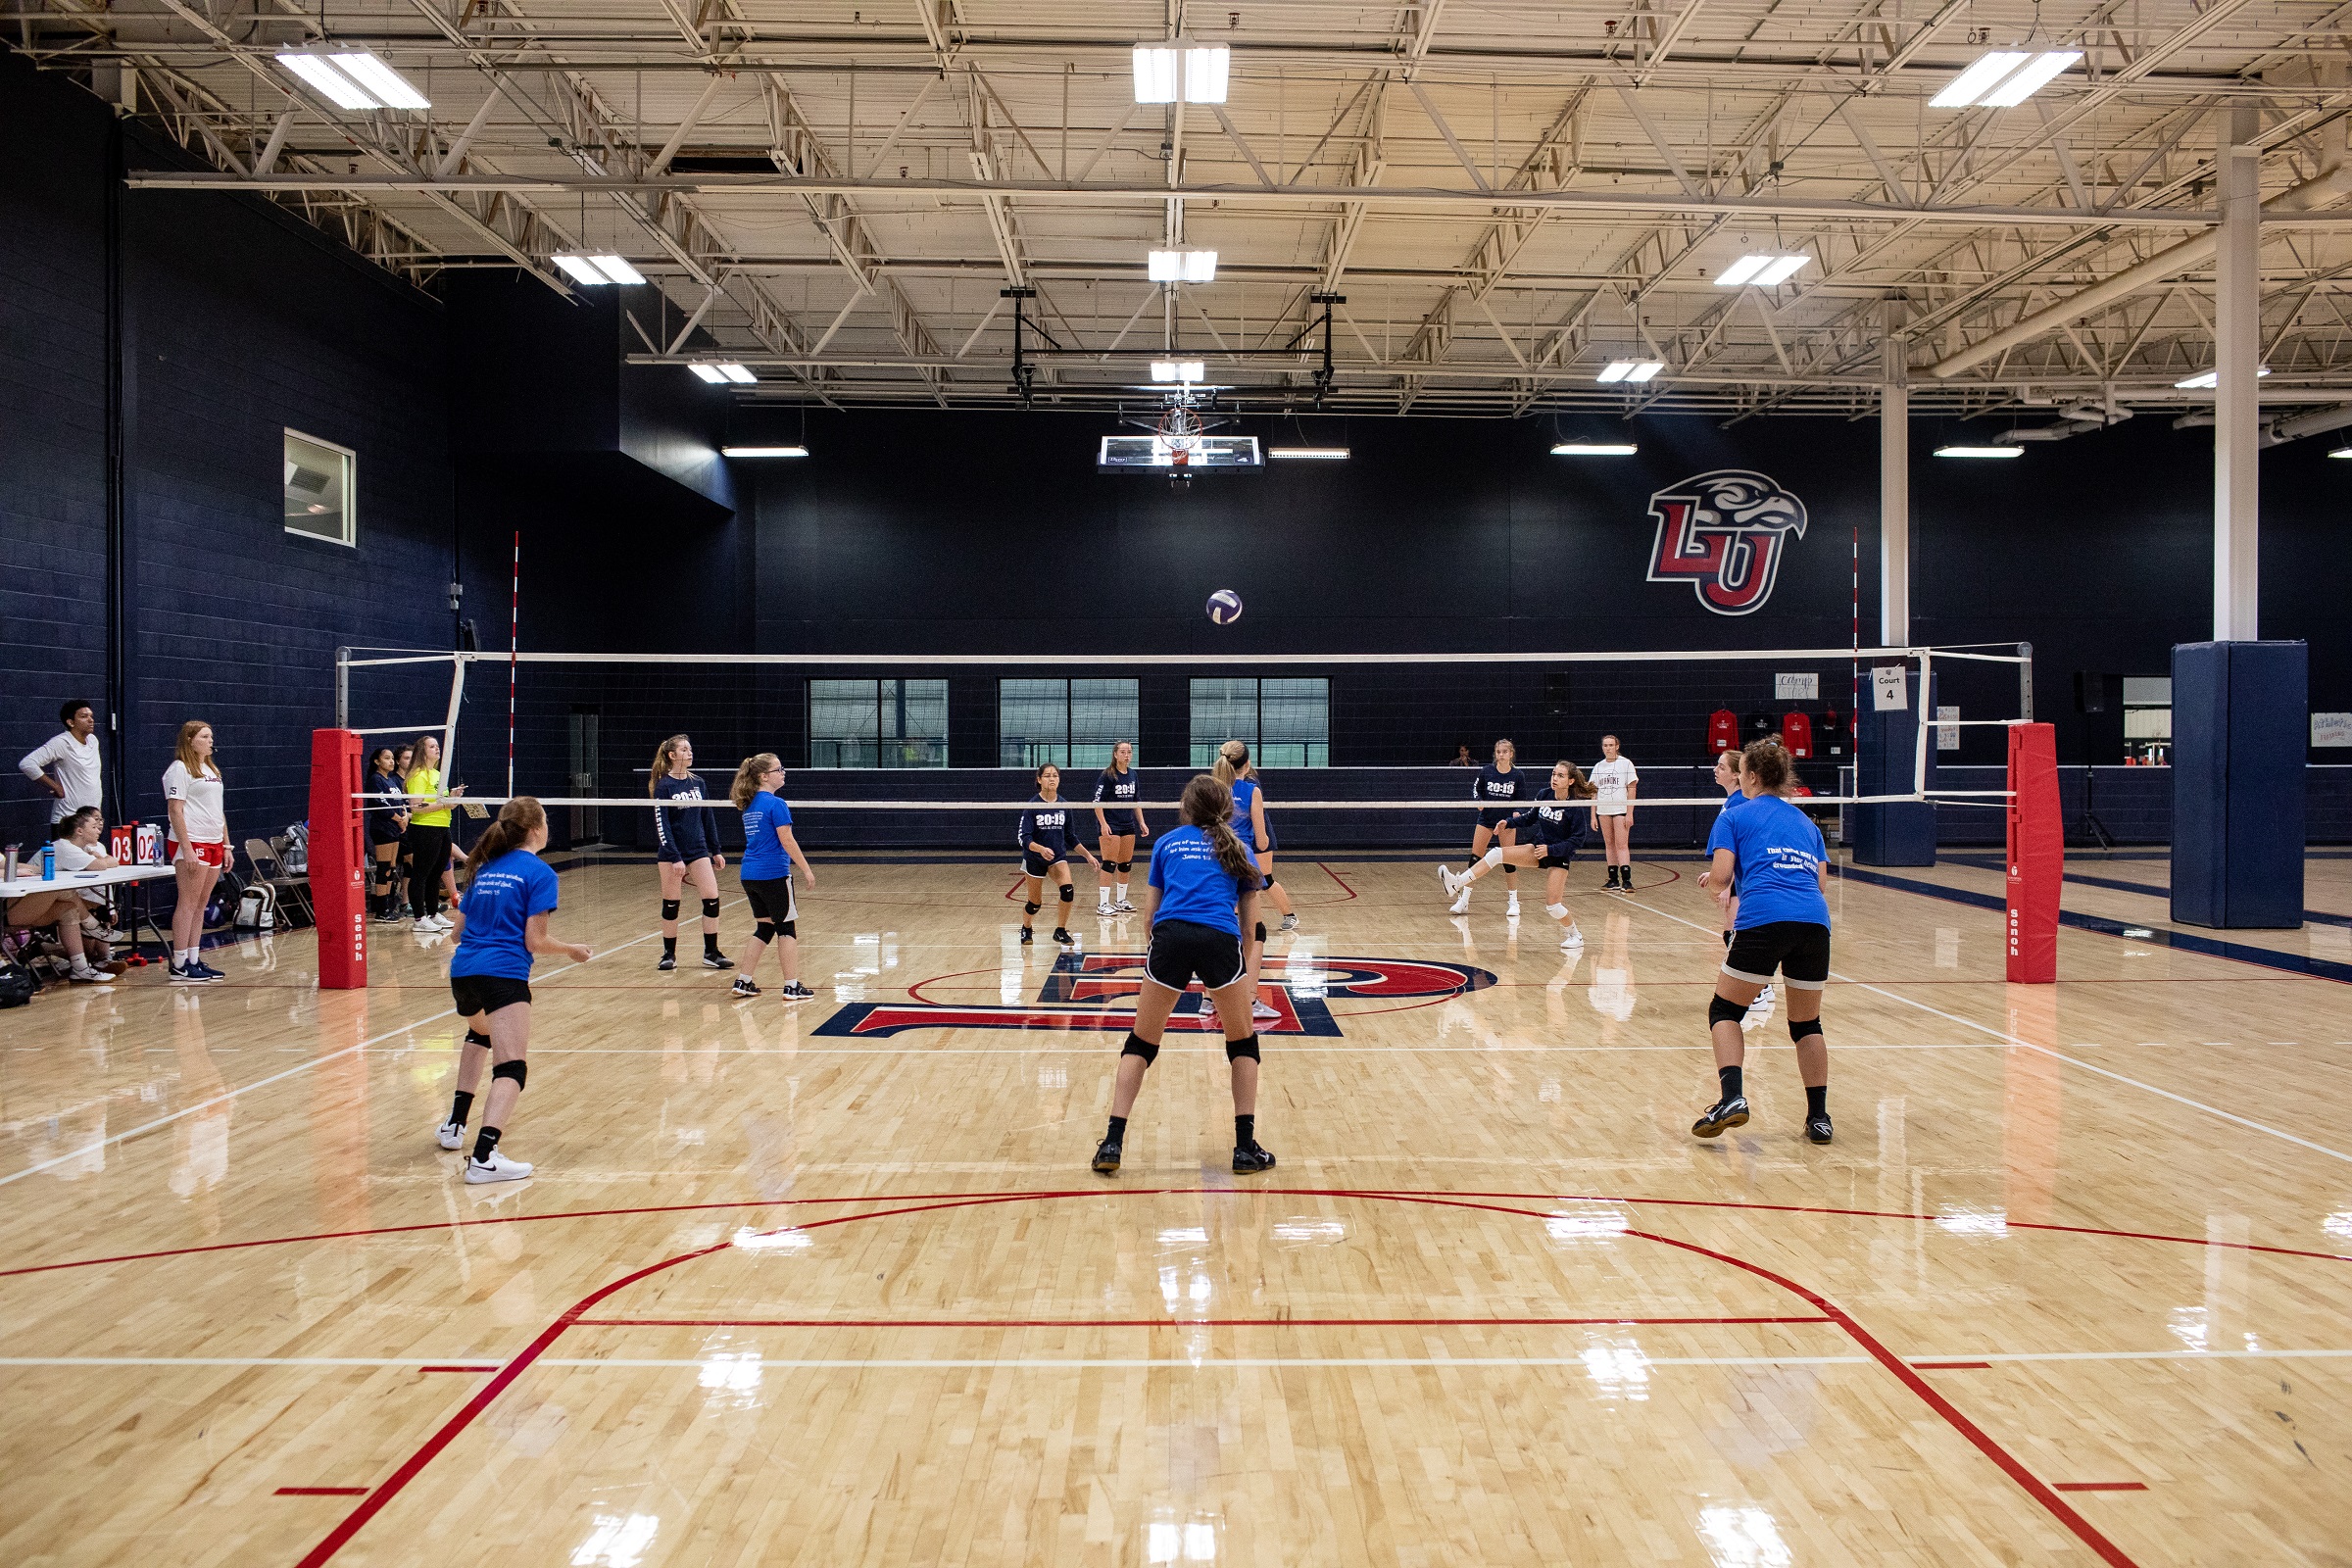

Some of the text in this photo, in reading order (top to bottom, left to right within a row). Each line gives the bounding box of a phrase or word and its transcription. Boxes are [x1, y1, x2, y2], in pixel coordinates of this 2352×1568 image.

[1646, 493, 1787, 615] LU
[1886, 689, 1894, 700] 4
[1487, 781, 1514, 795] 20:19
[655, 799, 667, 847] LLEYBALL
[1036, 813, 1065, 826] 20:19
[112, 836, 132, 862] 03
[139, 835, 154, 860] 02
